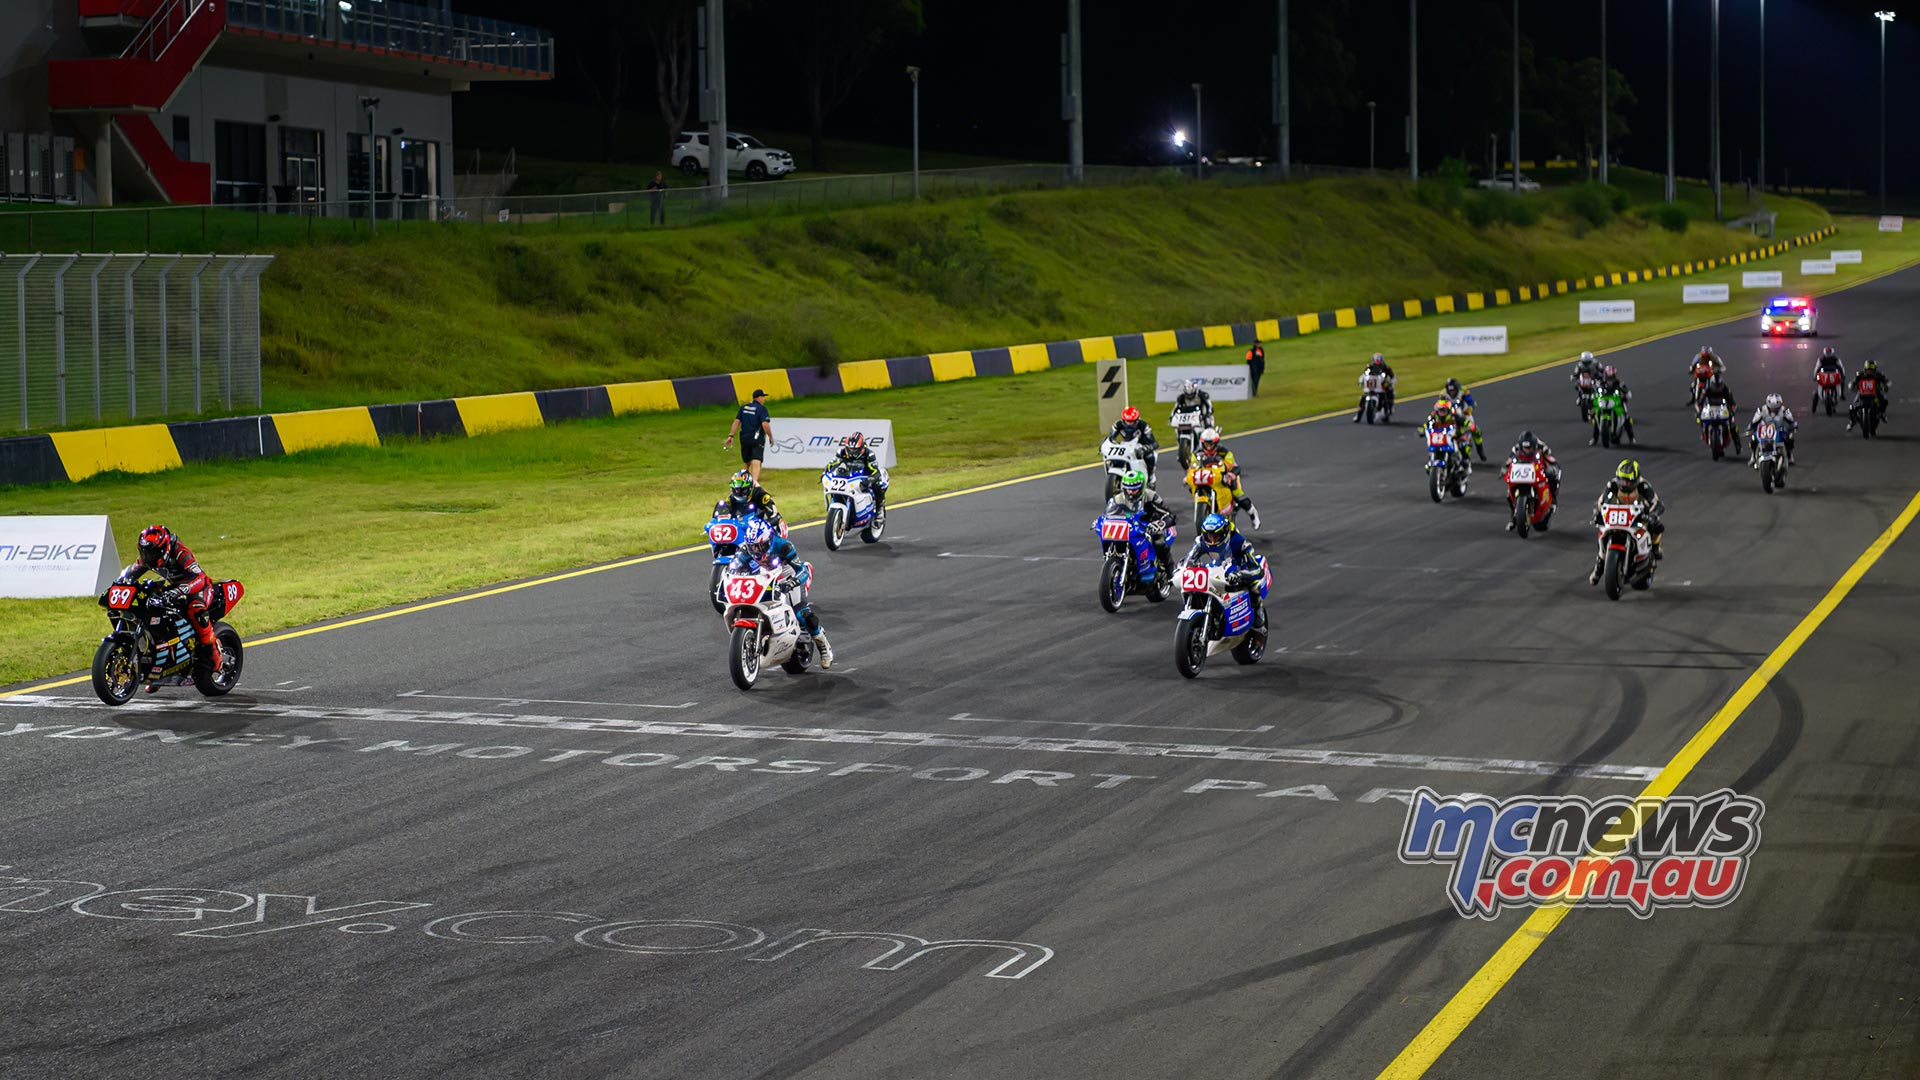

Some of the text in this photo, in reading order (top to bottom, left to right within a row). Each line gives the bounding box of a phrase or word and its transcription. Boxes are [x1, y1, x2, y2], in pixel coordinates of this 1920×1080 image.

[808, 436, 885, 448] MI-BE
[831, 479, 846, 492] 22
[1608, 510, 1628, 526] 88
[713, 526, 732, 542] 52
[1102, 521, 1128, 540] 777
[1183, 569, 1207, 590] 20
[110, 587, 131, 605] 89
[227, 584, 238, 601] 89
[729, 580, 756, 600] 43
[0, 723, 1440, 804] YDNEY MOTORSPORT PAR
